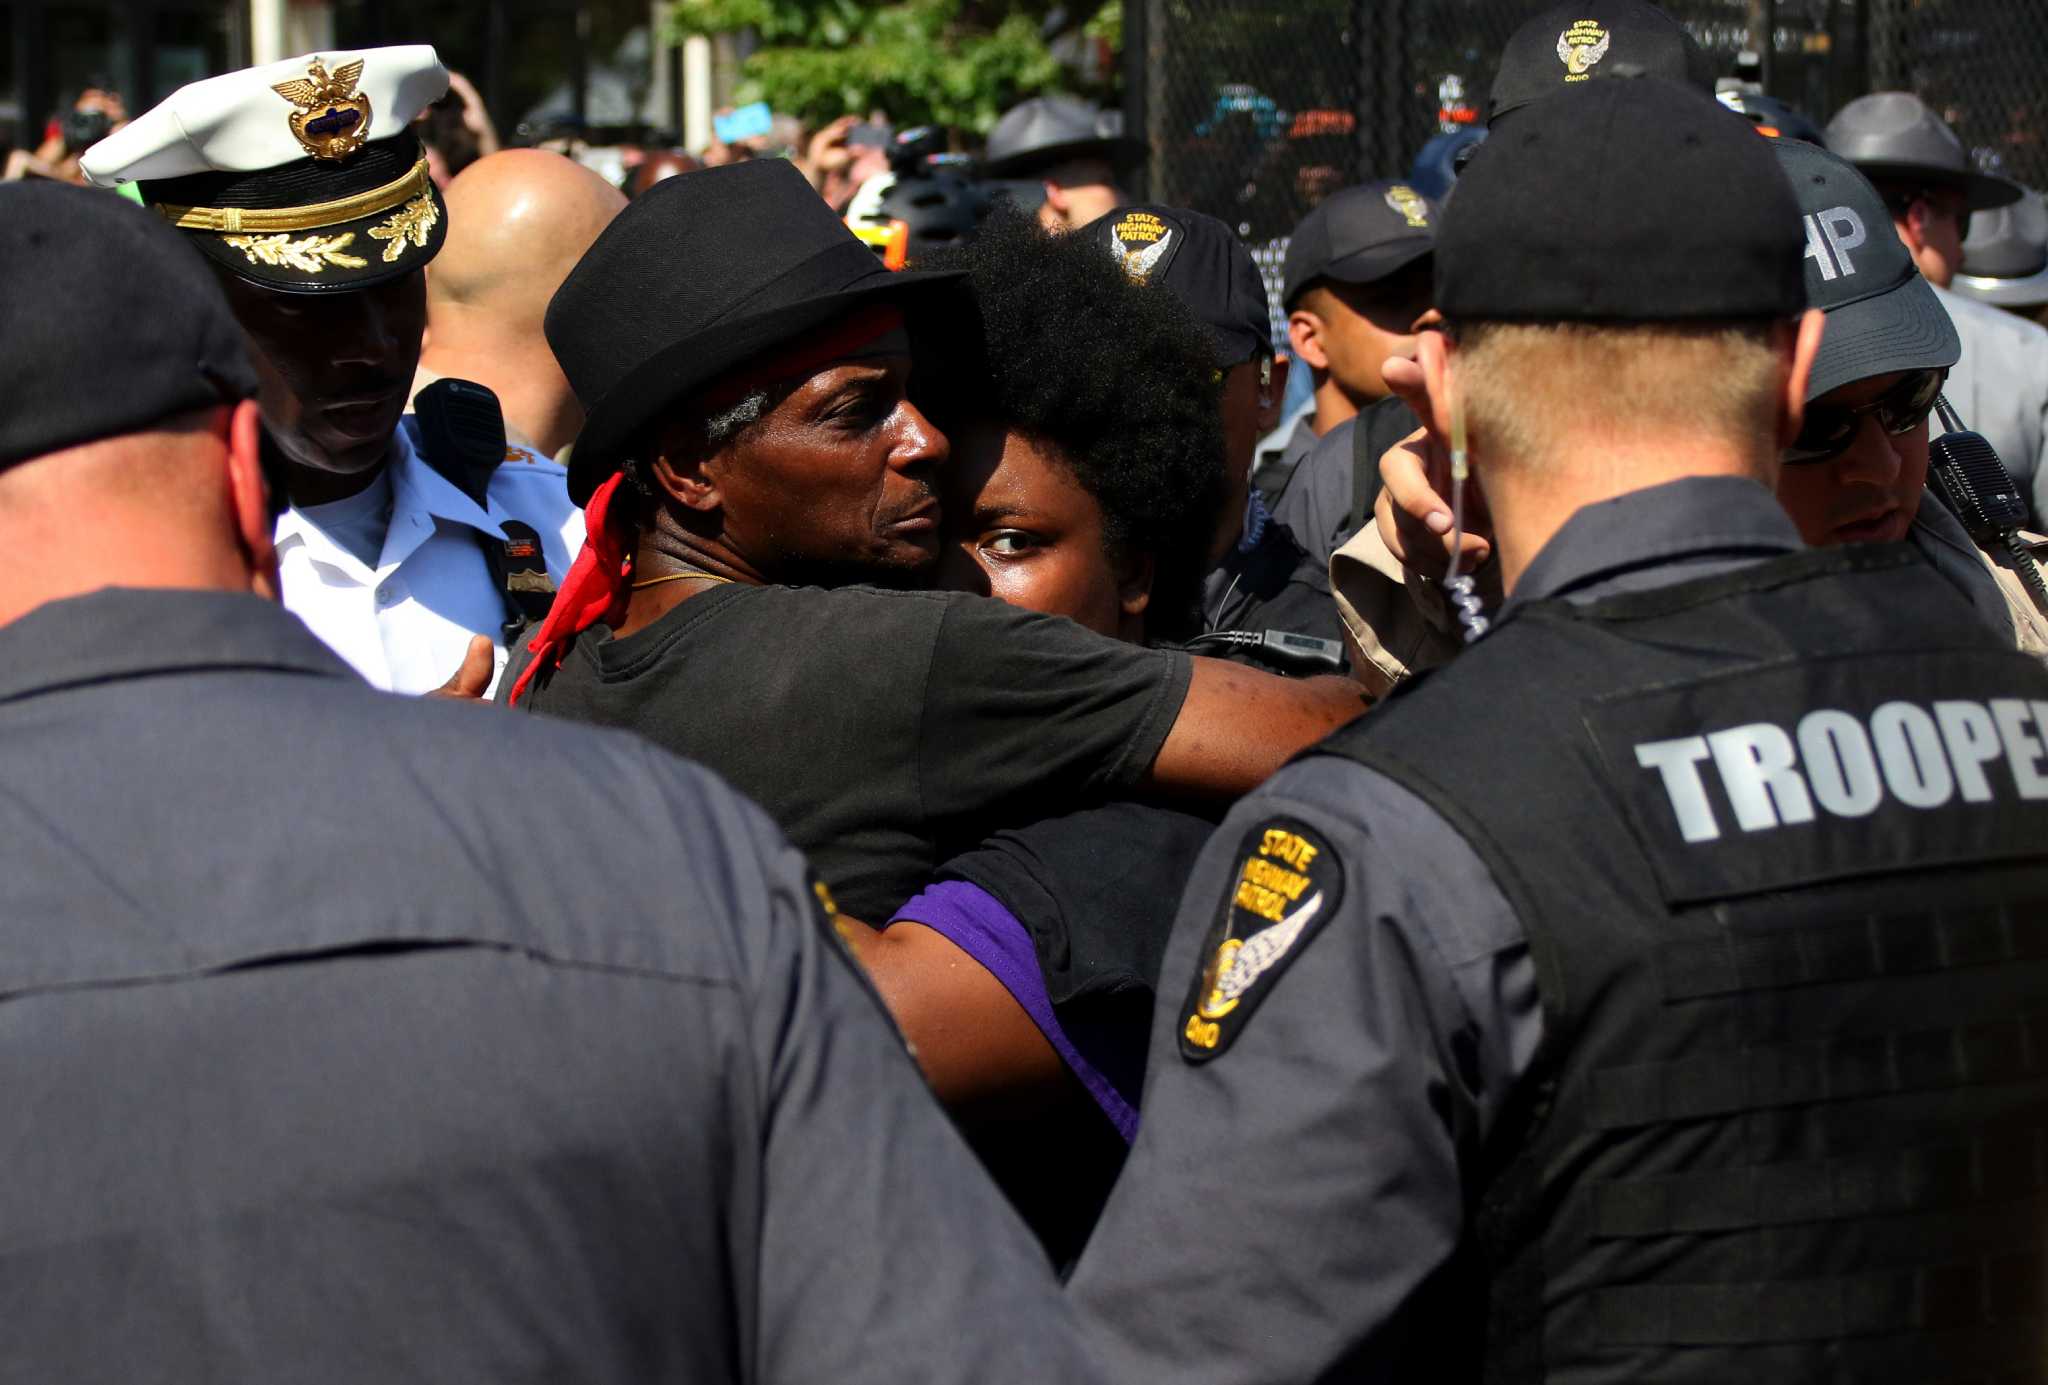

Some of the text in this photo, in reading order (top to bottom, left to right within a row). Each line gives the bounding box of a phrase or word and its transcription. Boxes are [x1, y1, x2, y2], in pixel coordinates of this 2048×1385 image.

[1573, 20, 1598, 28] STATE
[1566, 28, 1604, 37] HIGHWAY
[1568, 37, 1597, 45] PATROL
[1565, 74, 1589, 82] OHIO
[1126, 213, 1160, 224] STATE
[1116, 222, 1167, 234] HIGHWAY
[1119, 231, 1158, 241] PATROL
[1633, 698, 2048, 844] TROOPE
[1259, 828, 1318, 872] STATE
